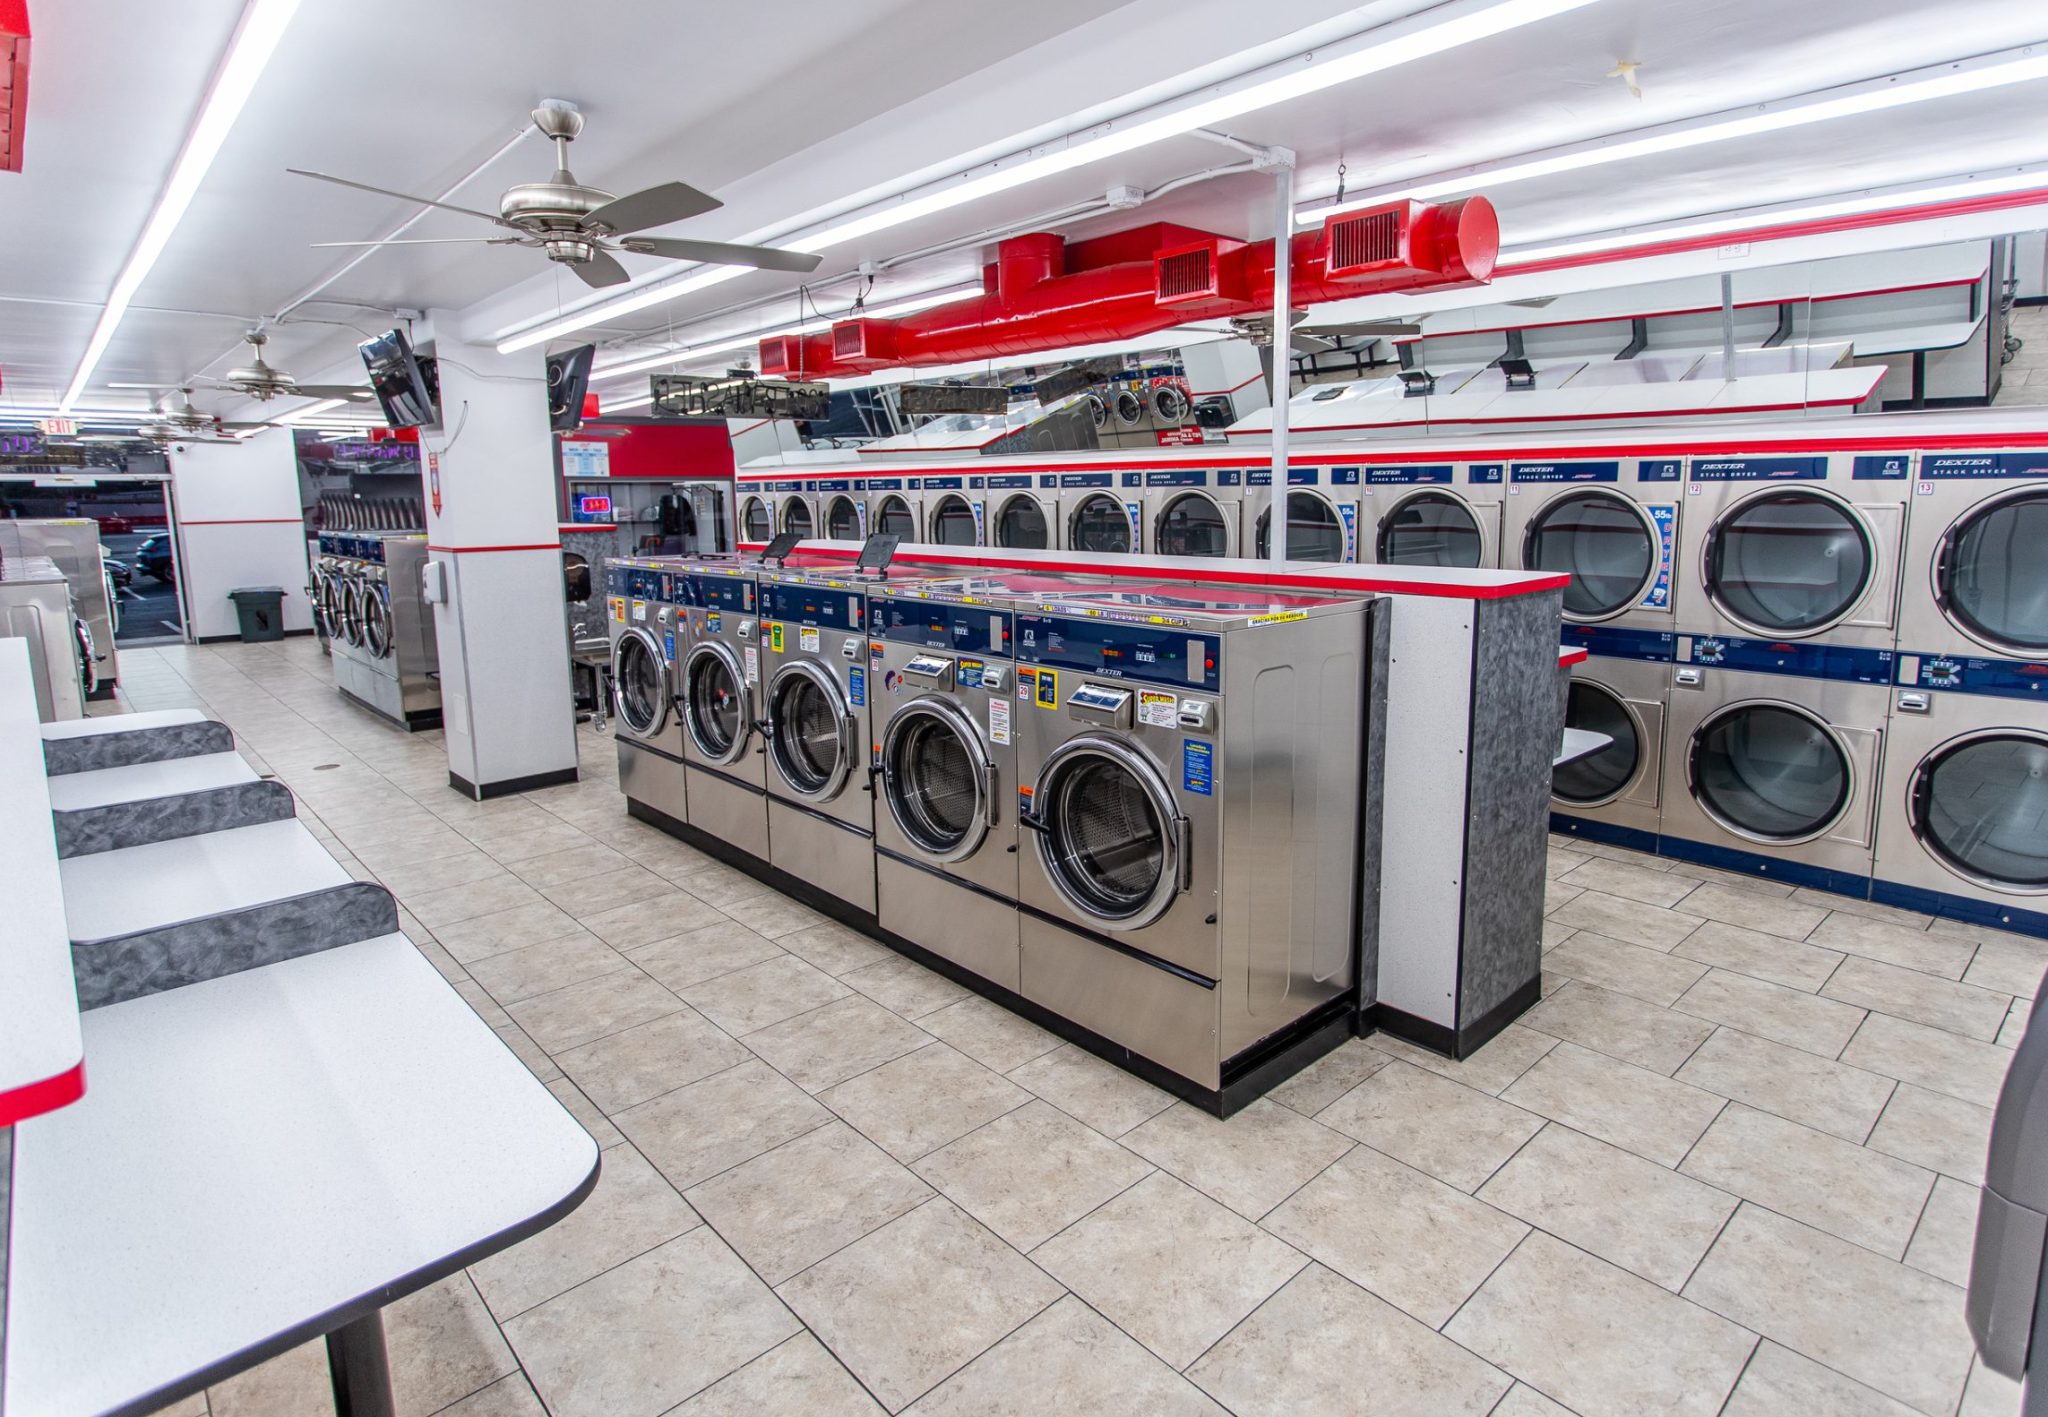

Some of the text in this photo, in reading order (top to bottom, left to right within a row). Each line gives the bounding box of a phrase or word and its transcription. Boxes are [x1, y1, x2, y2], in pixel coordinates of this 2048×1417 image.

[48, 420, 71, 433] EXIT
[1933, 459, 1992, 467] DEXTER
[1920, 484, 1931, 492] 13
[1654, 509, 1672, 519] 55lb
[1660, 522, 1672, 585] DRYER
[1095, 667, 1123, 677] DEXTER
